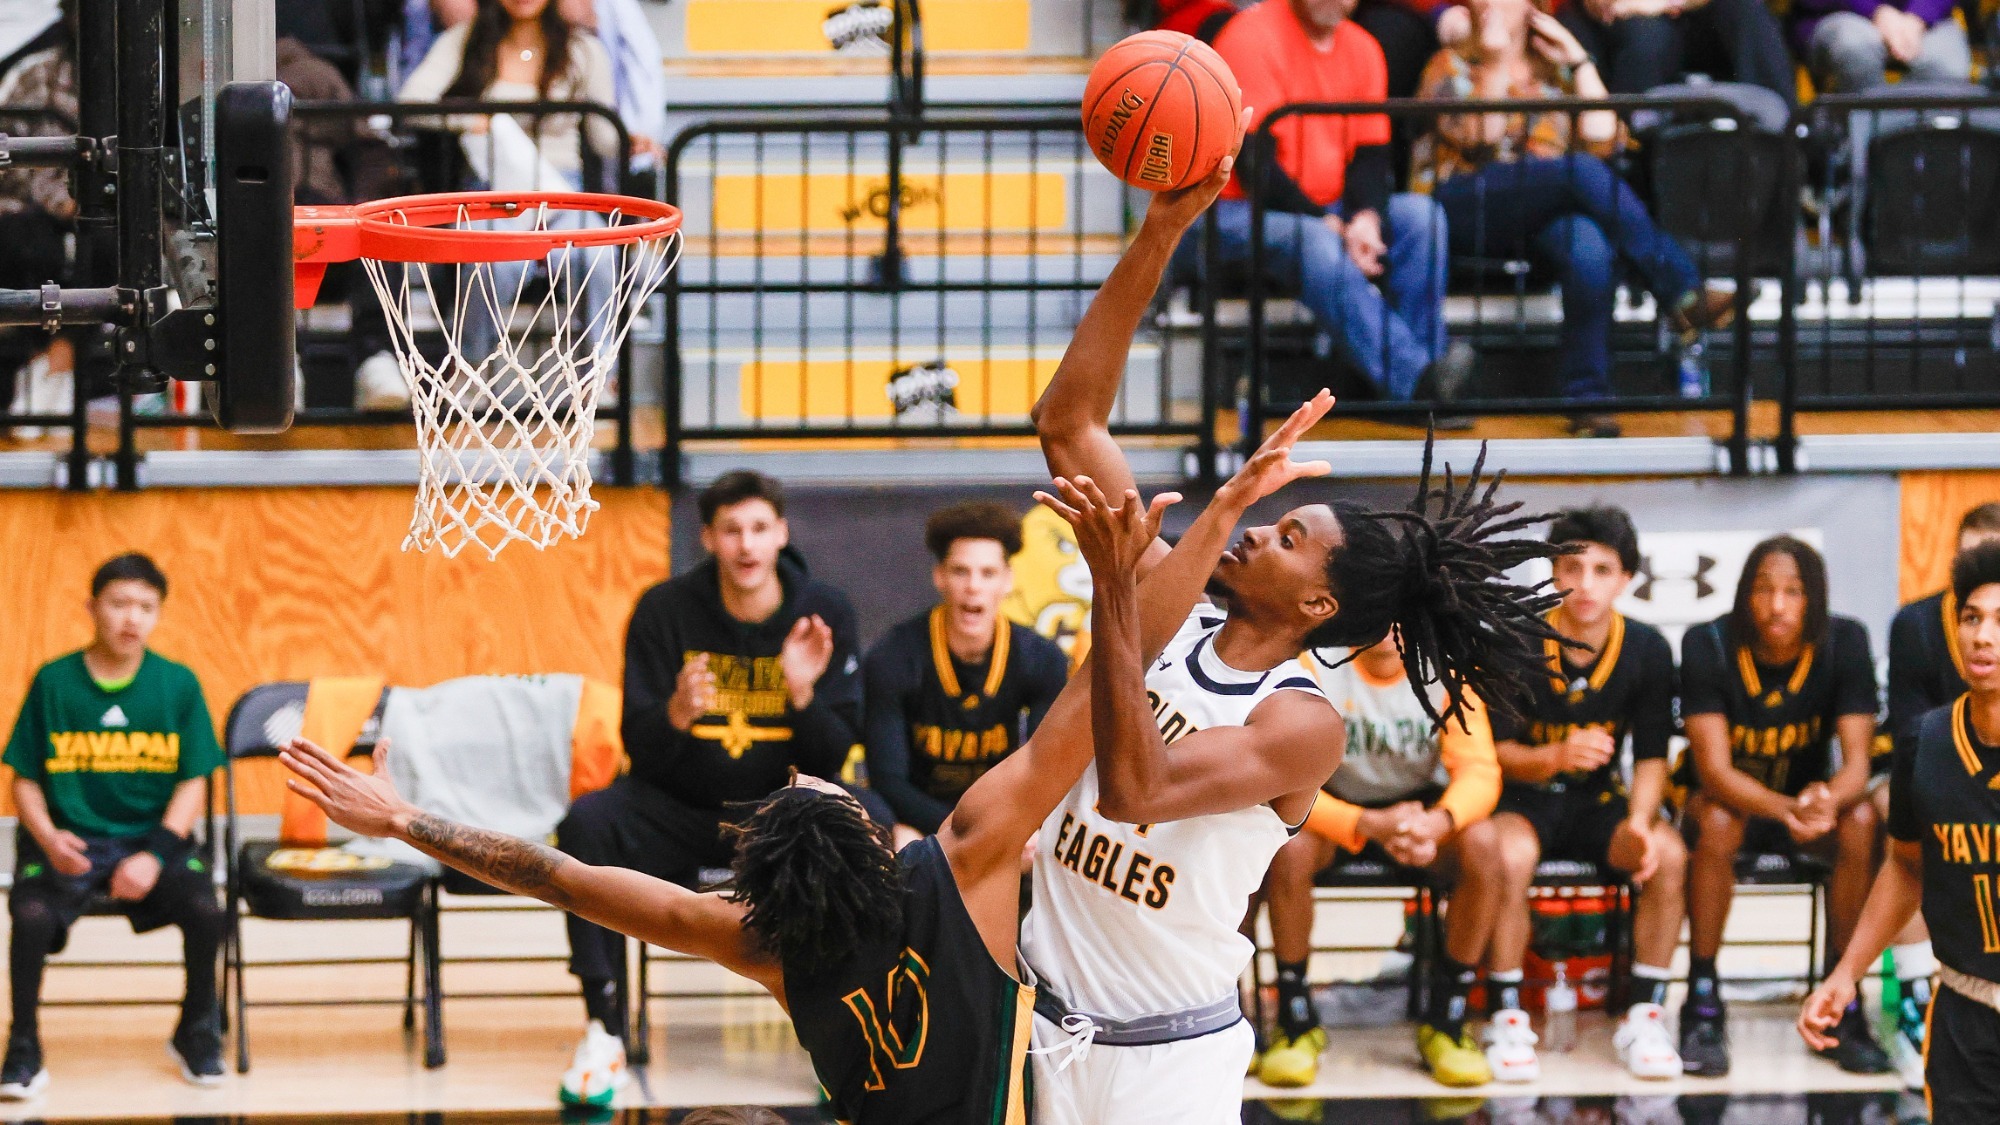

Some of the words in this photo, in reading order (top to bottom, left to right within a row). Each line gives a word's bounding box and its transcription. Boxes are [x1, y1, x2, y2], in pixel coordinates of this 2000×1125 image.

[1138, 133, 1170, 184] NJCAA
[50, 731, 180, 758] YAVAPAI
[1054, 810, 1177, 910] EAGLES
[1932, 823, 2000, 864] YAV
[841, 946, 931, 1091] 10
